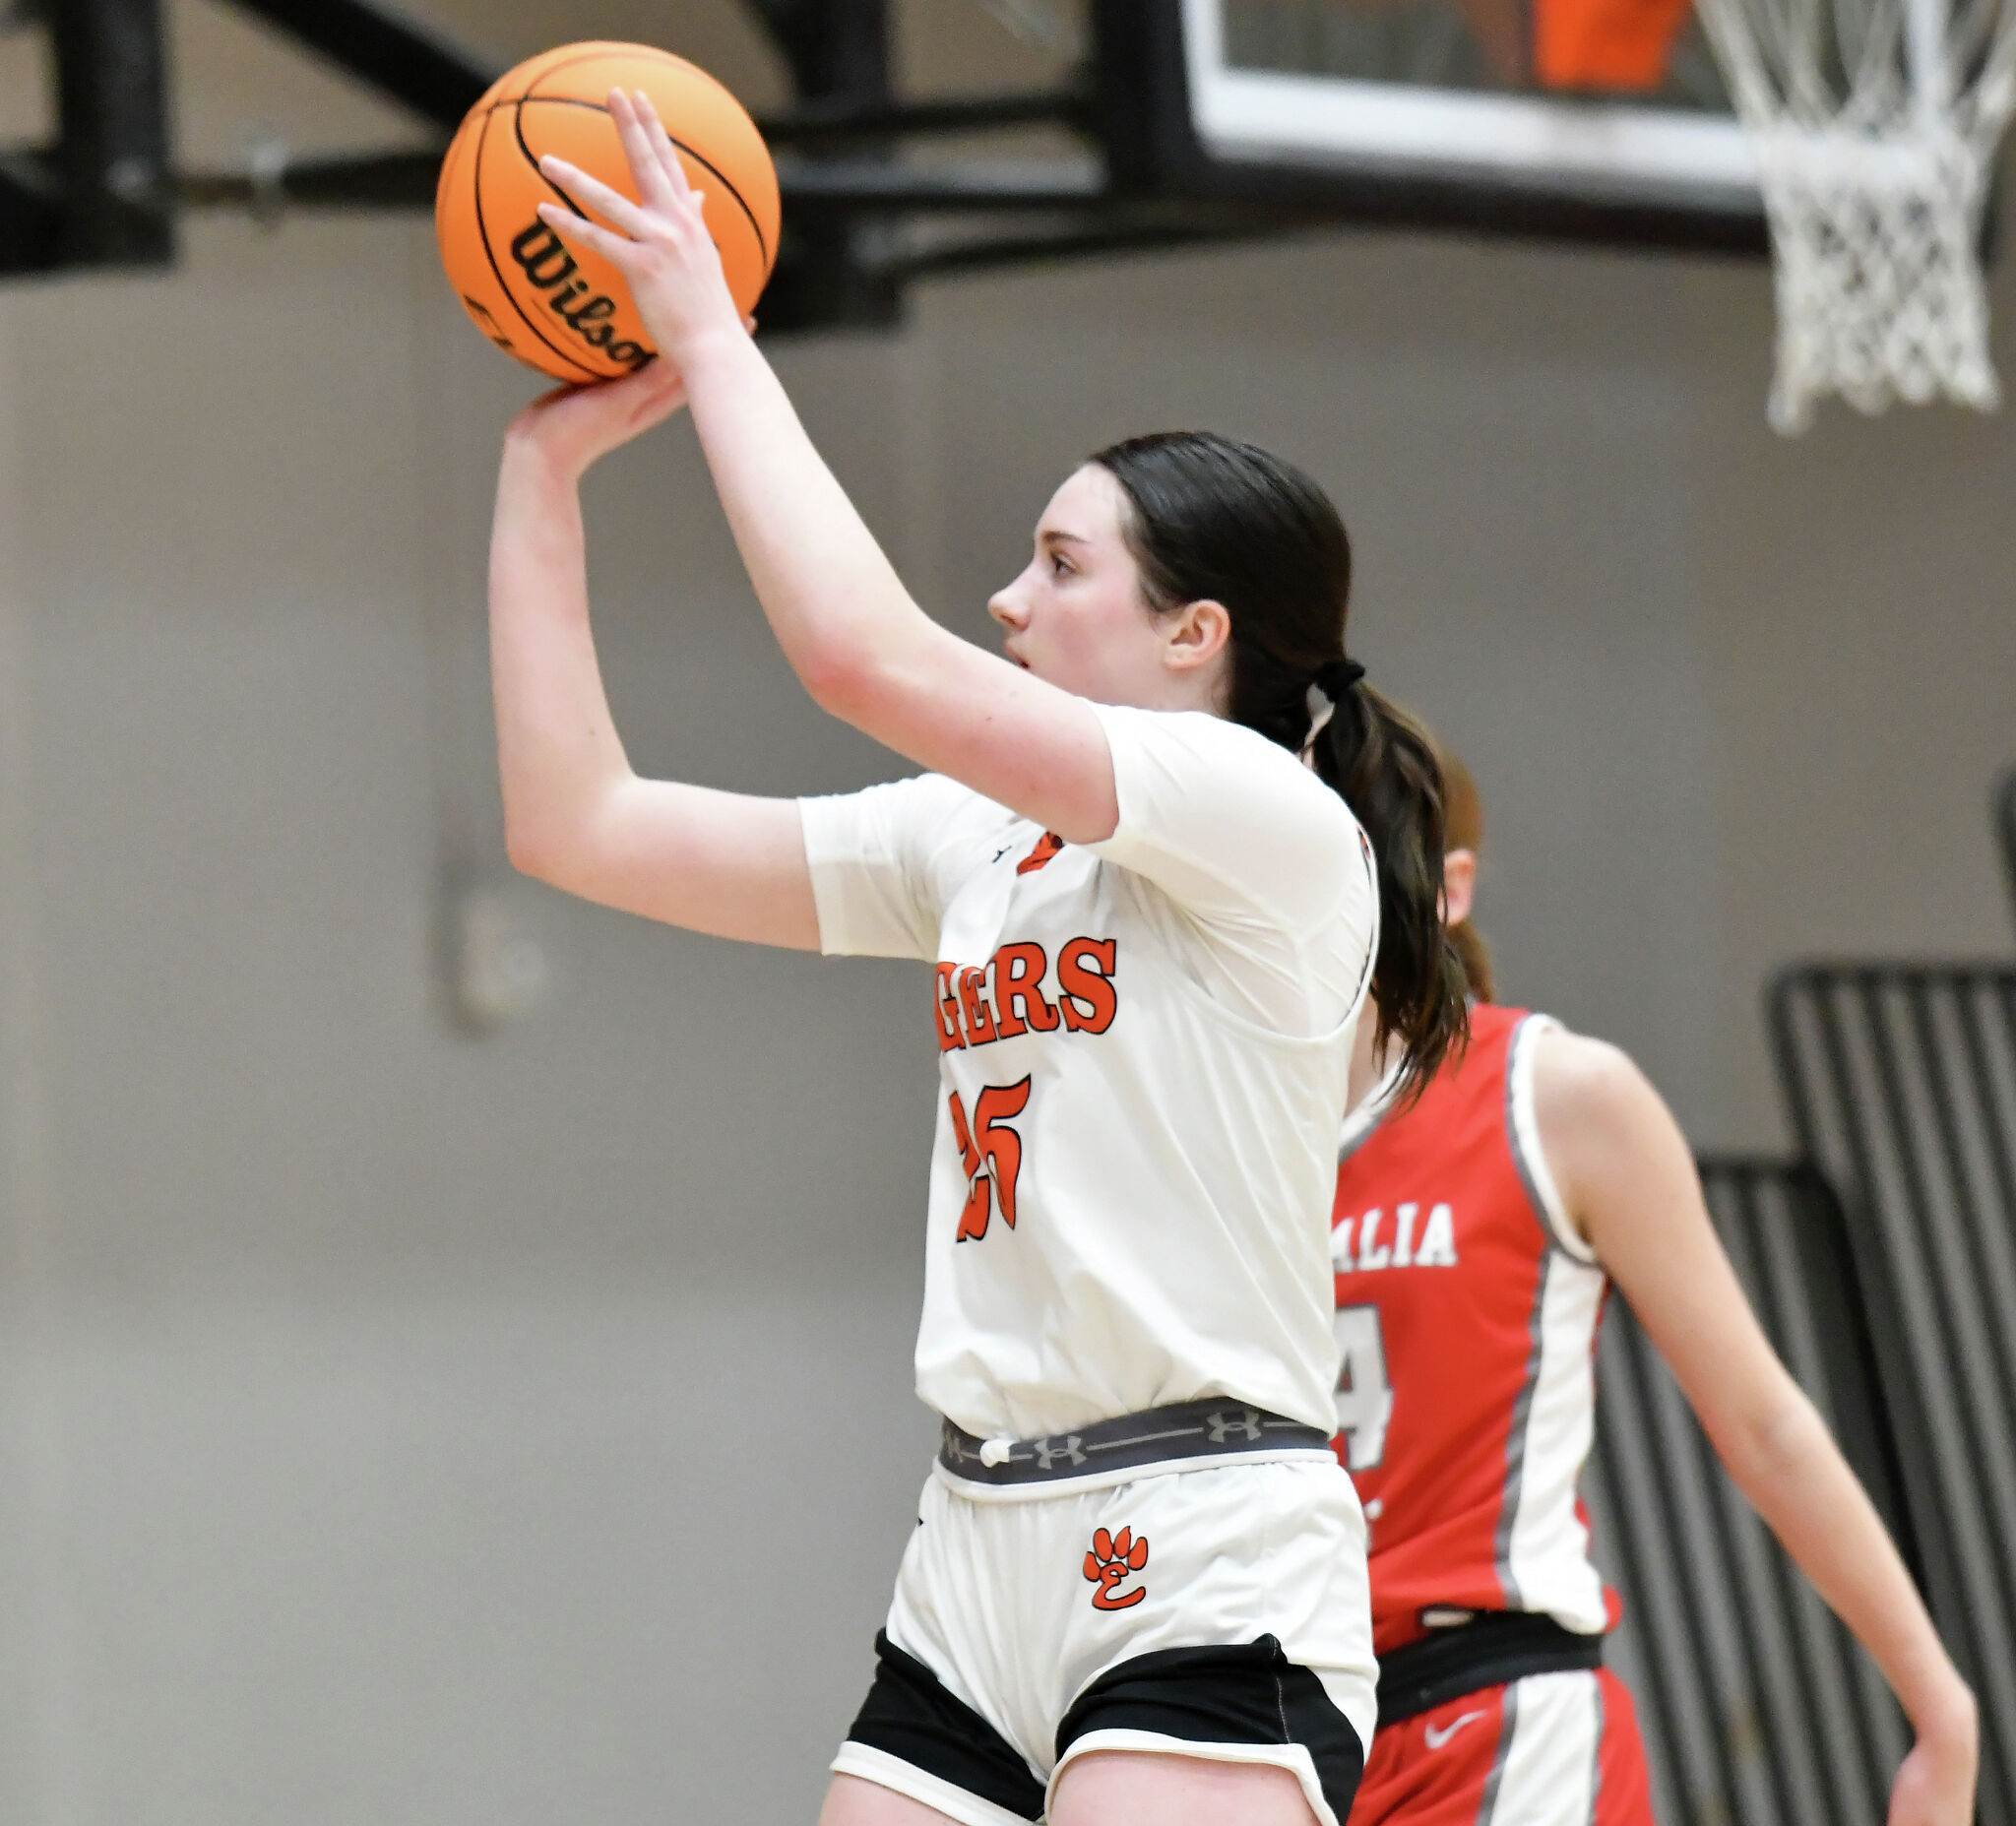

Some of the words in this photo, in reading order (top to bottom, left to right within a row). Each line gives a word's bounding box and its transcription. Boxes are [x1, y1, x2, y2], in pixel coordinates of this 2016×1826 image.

[511, 212, 659, 372] Wilso
[948, 1072, 1032, 1243] 25
[1335, 1302, 1395, 1472] 4
